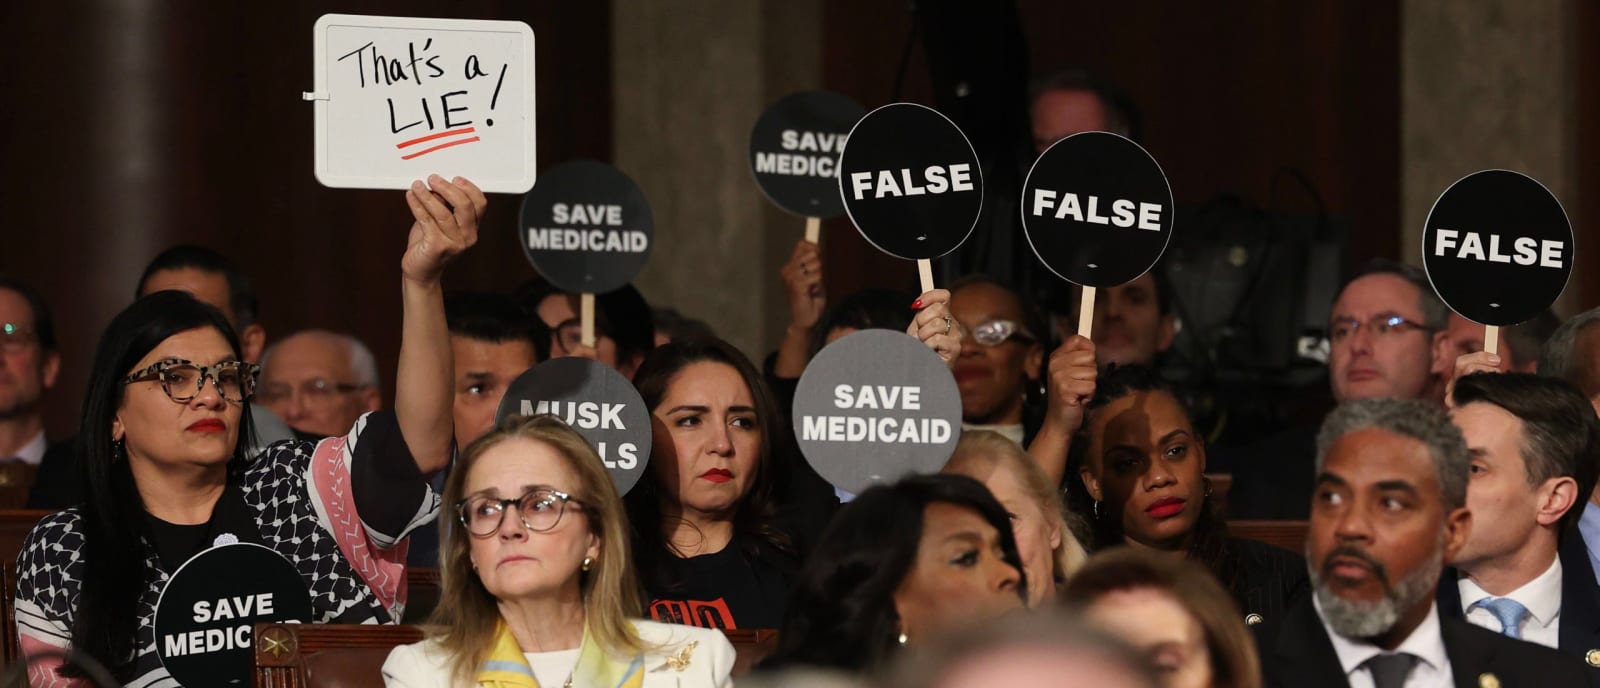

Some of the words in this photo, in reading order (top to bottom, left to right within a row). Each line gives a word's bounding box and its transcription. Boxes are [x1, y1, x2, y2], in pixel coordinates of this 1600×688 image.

[337, 38, 445, 88] That's
[464, 54, 489, 80] a
[755, 151, 841, 178] MEDIC
[850, 163, 974, 200] FALSE
[552, 203, 623, 226] SAVE
[1032, 188, 1163, 232] FALSE
[528, 228, 648, 253] MEDICAID
[1434, 228, 1564, 269] FALSE
[834, 384, 921, 410] SAVE
[802, 415, 952, 444] MEDICAID
[192, 592, 275, 624] SAVE
